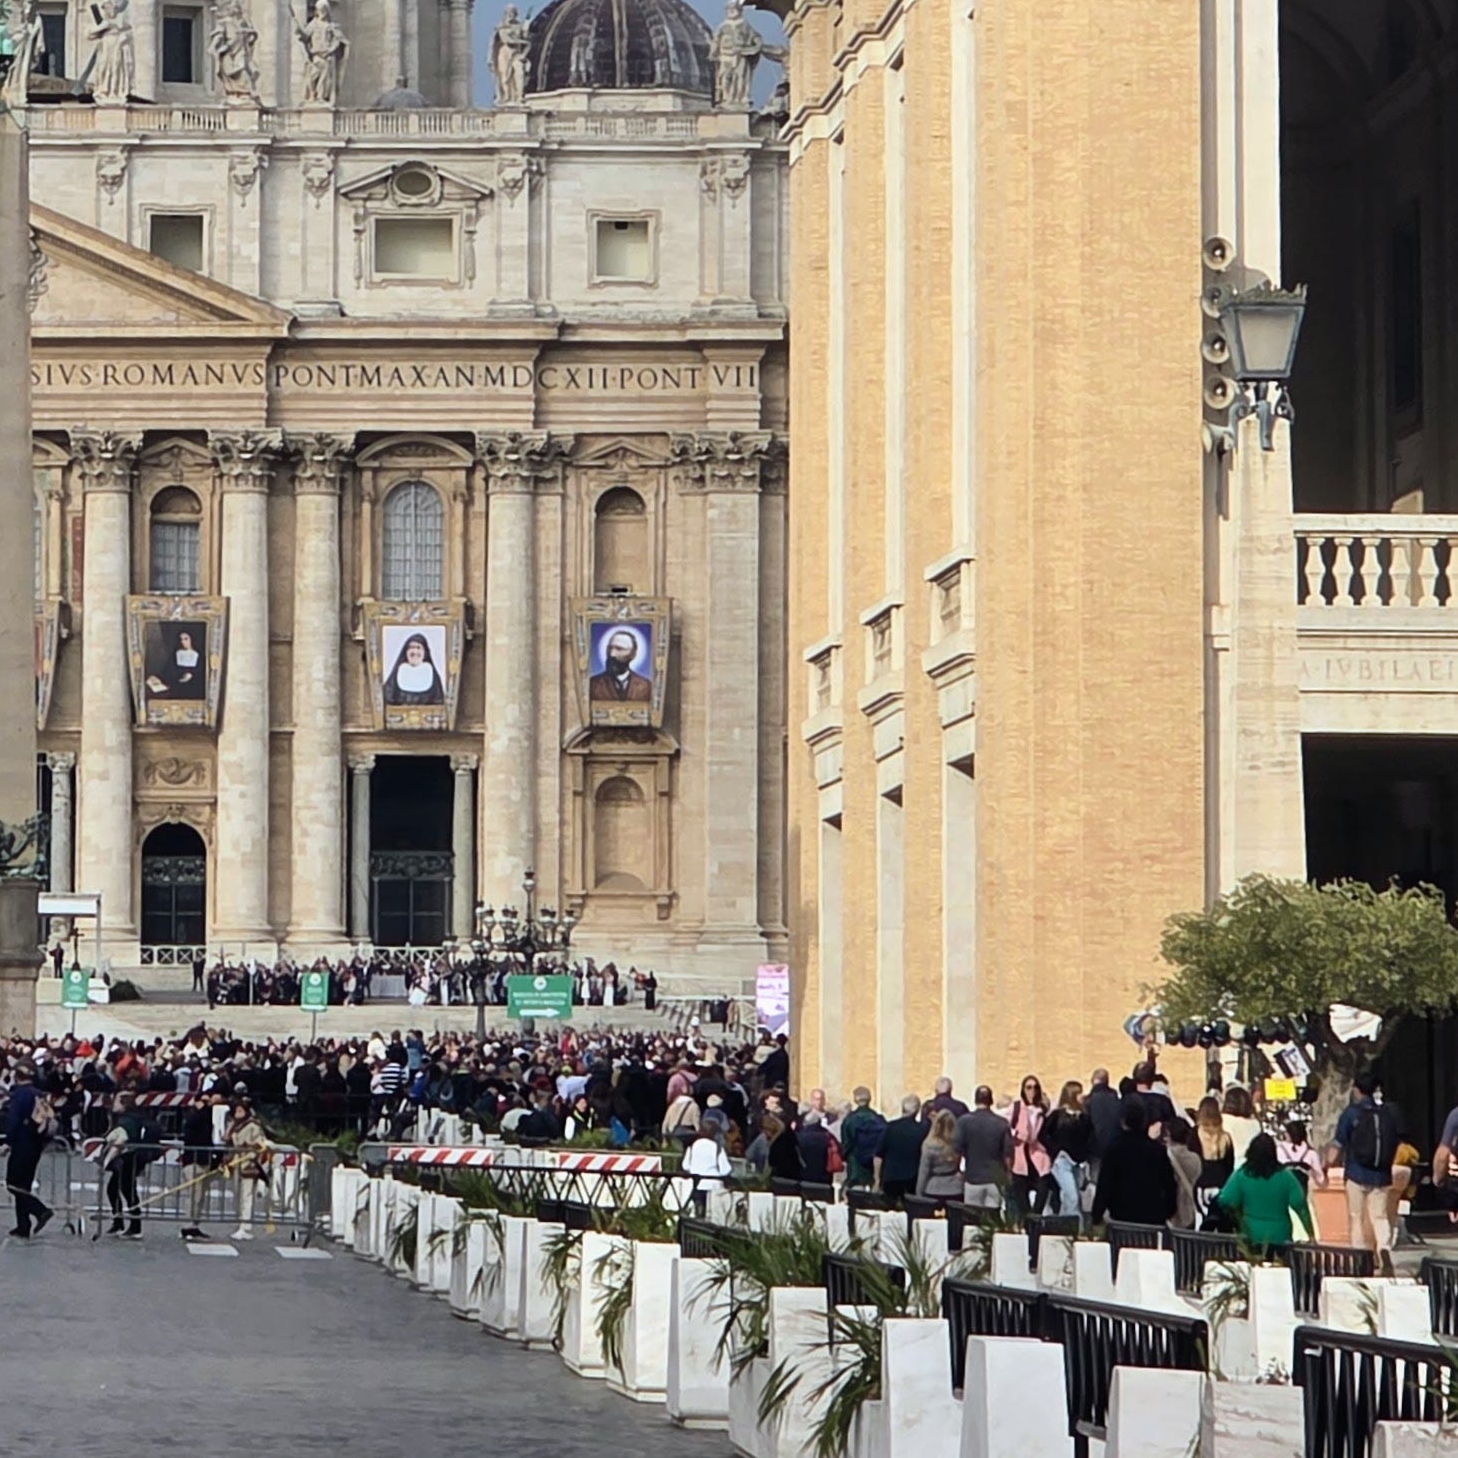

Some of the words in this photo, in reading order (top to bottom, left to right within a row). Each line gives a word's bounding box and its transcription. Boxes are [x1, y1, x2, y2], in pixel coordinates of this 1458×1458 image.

[102, 363, 264, 387] ROMANVS
[274, 364, 356, 389] PONT
[359, 365, 428, 389] MAX
[433, 365, 475, 389] AN
[618, 367, 703, 391] PONT
[712, 365, 756, 389] VII
